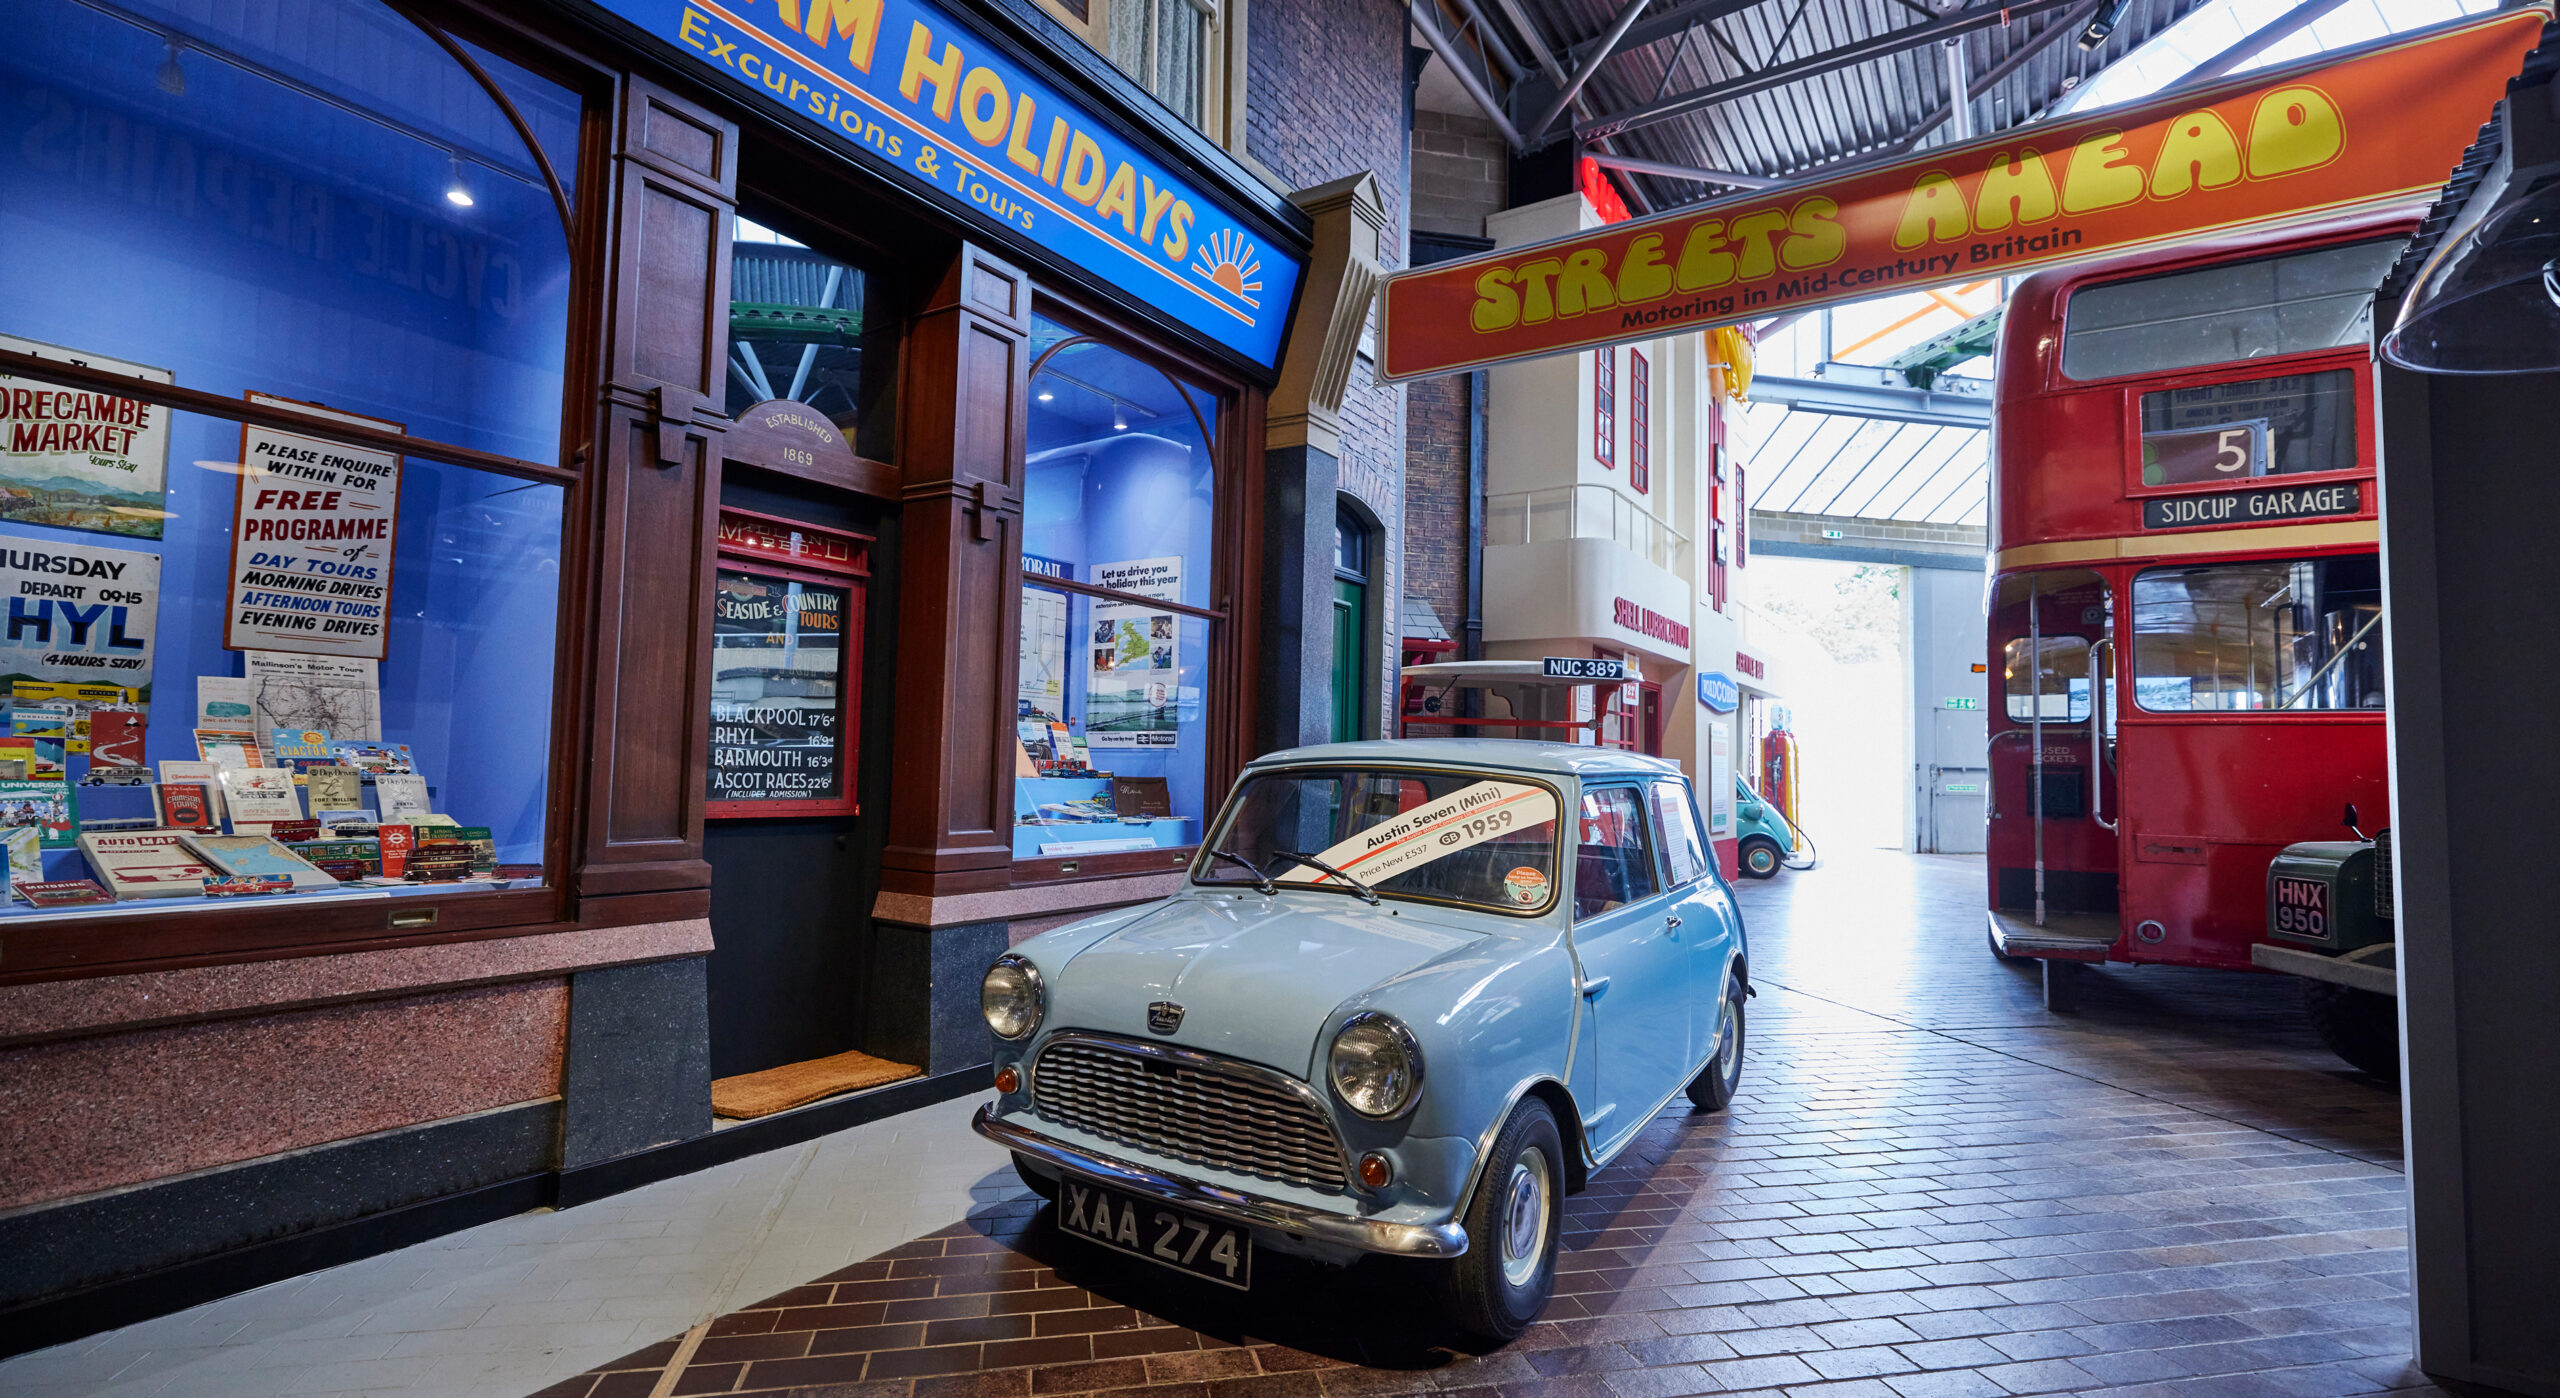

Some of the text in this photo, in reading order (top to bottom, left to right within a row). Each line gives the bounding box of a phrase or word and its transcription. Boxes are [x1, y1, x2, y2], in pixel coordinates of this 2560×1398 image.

[679, 7, 1035, 230] Excursions & Tours
[899, 20, 1195, 262] HOLIDAYS
[1470, 84, 2347, 334] STREETS AHEAD
[1621, 226, 2081, 329] Motoring in Mid-Century Britain
[12, 423, 138, 456] MARKET
[765, 413, 833, 444] ESTABLISHED
[255, 441, 392, 479] PLEASE ENQUIRE
[784, 447, 813, 466] 1869
[267, 460, 377, 491] WITHIN FOR
[254, 489, 342, 511] FREE
[2161, 487, 2346, 523] SIDCUP GARAGE
[244, 518, 389, 542] PROGRAMME
[343, 544, 368, 562] of
[249, 552, 378, 580] DAY TOURS
[1102, 565, 1168, 580] Let us drive you
[20, 581, 142, 604] DEPART 09-15
[241, 571, 383, 599] MORNING DRIVES
[1106, 576, 1138, 589] holiday
[1139, 575, 1155, 586] this
[1157, 575, 1178, 588] year
[241, 591, 381, 618] AFTERNOON TOURS
[717, 592, 840, 620] SEASIDE & COUNTRY
[240, 611, 379, 636] EVENING DRIVES
[799, 611, 838, 630] TOURS
[1614, 596, 1690, 650] SHELL LUBRICATION
[766, 632, 794, 645] AND
[61, 655, 107, 667] HOURS
[110, 658, 146, 670] STAY)
[251, 660, 302, 670] Mallinson's
[307, 664, 335, 672] Motor
[339, 665, 364, 673] Tours
[1550, 659, 1617, 678] NUC 389
[716, 704, 806, 726] BLACKPOOL
[715, 727, 758, 745] RHYL
[1152, 735, 1175, 743] Motorail
[280, 745, 328, 757] CLACTON
[714, 749, 801, 767] BARMOUTH
[714, 772, 762, 789] ASCOT
[766, 773, 807, 789] RACES
[769, 790, 812, 799] ADMISSION)
[1366, 787, 1502, 849] Austin Seven (Mini)
[1441, 810, 1513, 846] GB 1959
[97, 837, 176, 846] AUTO MAP
[1359, 844, 1428, 880] Price New £537
[25, 882, 86, 890] MOTORING
[2279, 880, 2322, 908] HNX
[2280, 906, 2323, 934] 950
[1068, 1184, 1238, 1278] XAA 274
